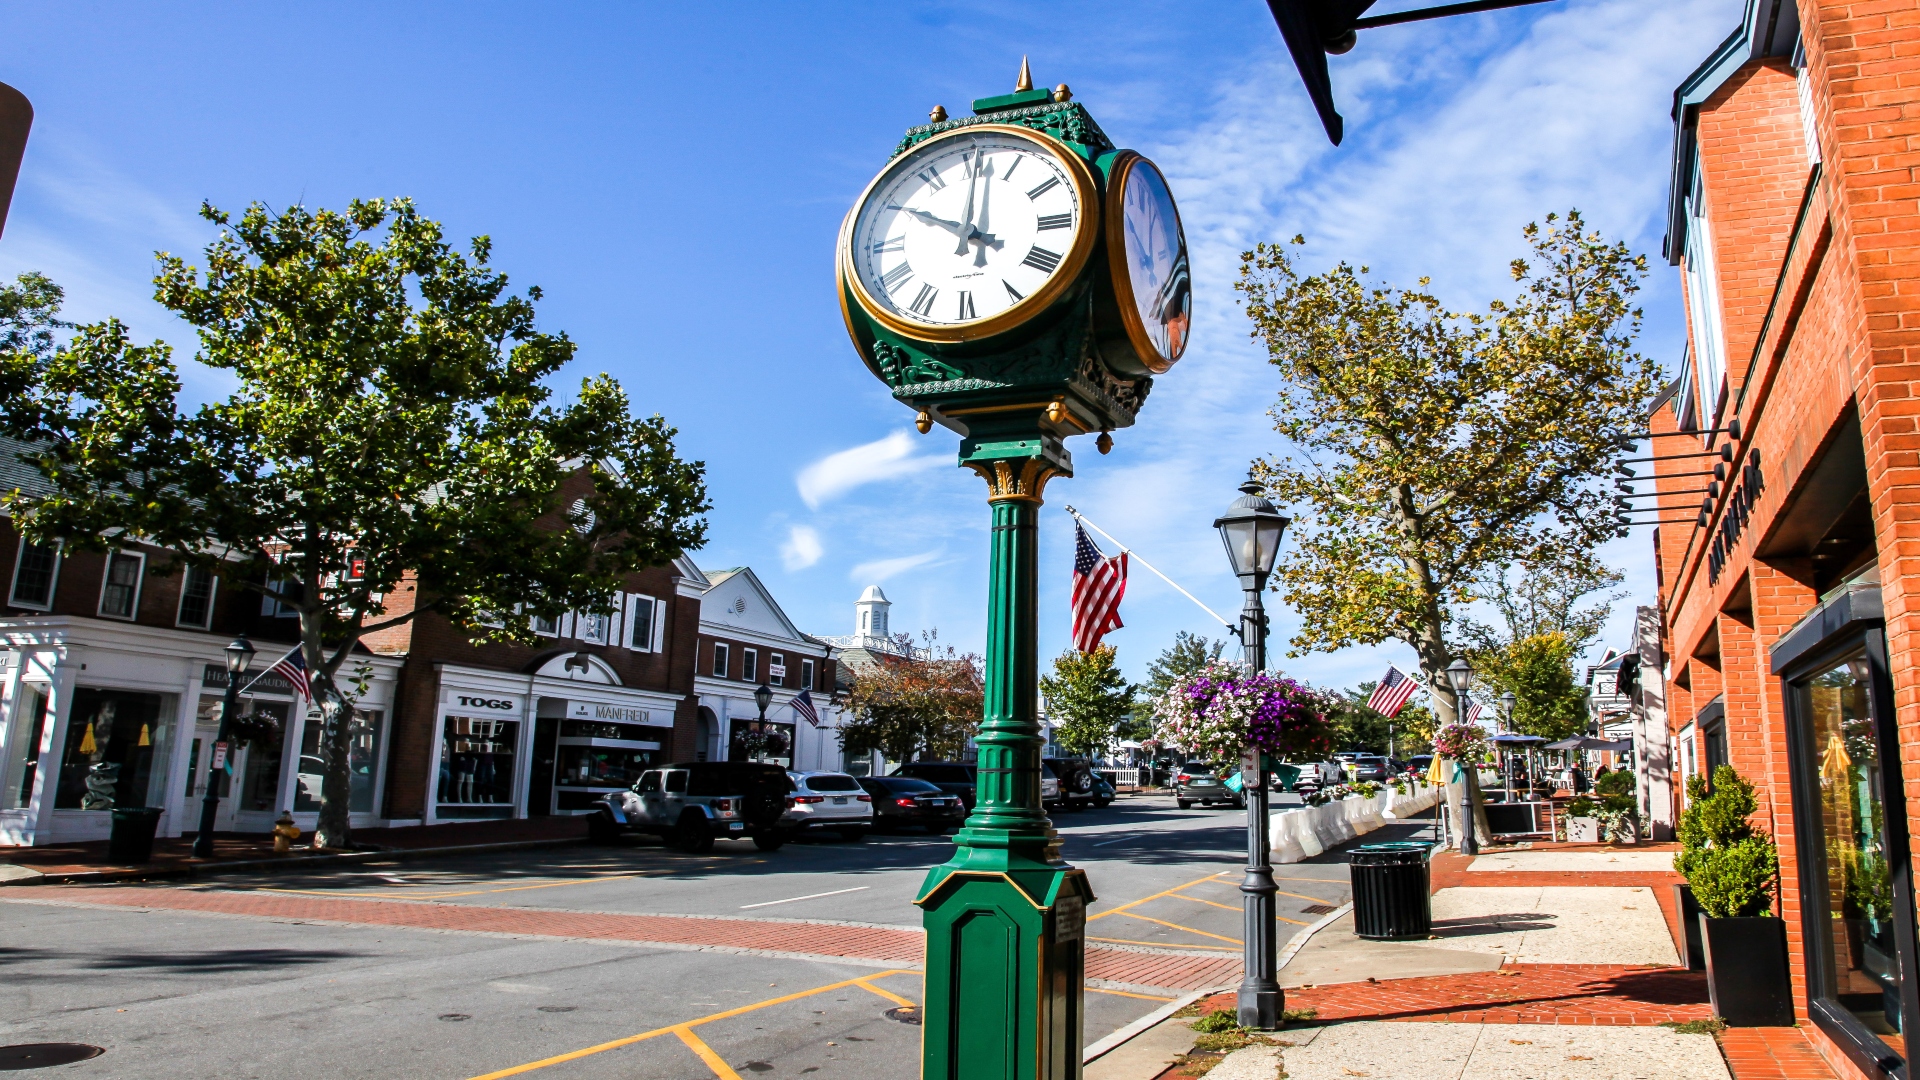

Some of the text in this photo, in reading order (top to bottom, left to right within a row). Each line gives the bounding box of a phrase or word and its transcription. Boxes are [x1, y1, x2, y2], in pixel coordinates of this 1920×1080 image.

[1025, 174, 1062, 203] II
[1036, 208, 1072, 234] III
[1019, 243, 1065, 278] IIII
[954, 290, 981, 321] VI
[1001, 278, 1028, 306] V
[207, 670, 293, 689] HEAER GAUDIO
[457, 695, 513, 710] TOGS
[596, 706, 650, 722] MANFREDI
